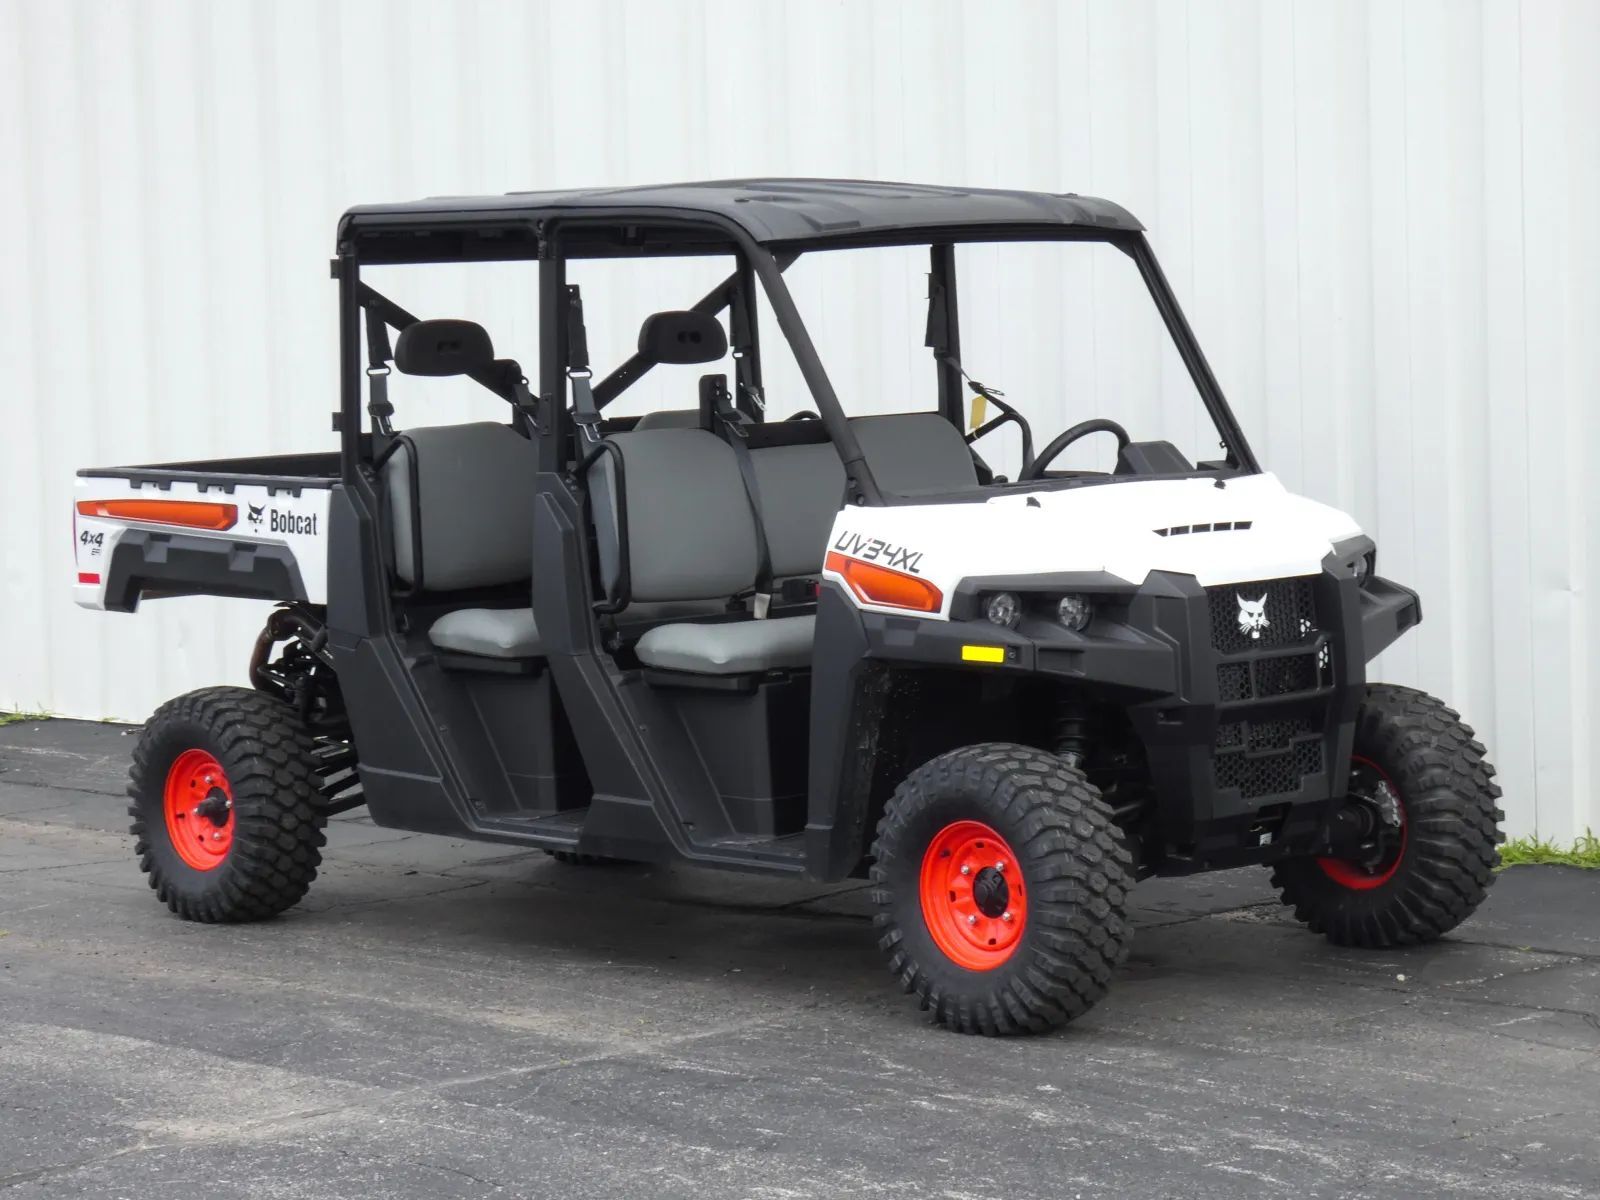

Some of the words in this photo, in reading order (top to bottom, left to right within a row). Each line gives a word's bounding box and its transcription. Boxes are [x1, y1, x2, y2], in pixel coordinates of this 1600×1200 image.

[270, 509, 317, 536] Bobcat
[80, 530, 104, 547] 4x4
[834, 530, 924, 574] UV34XL
